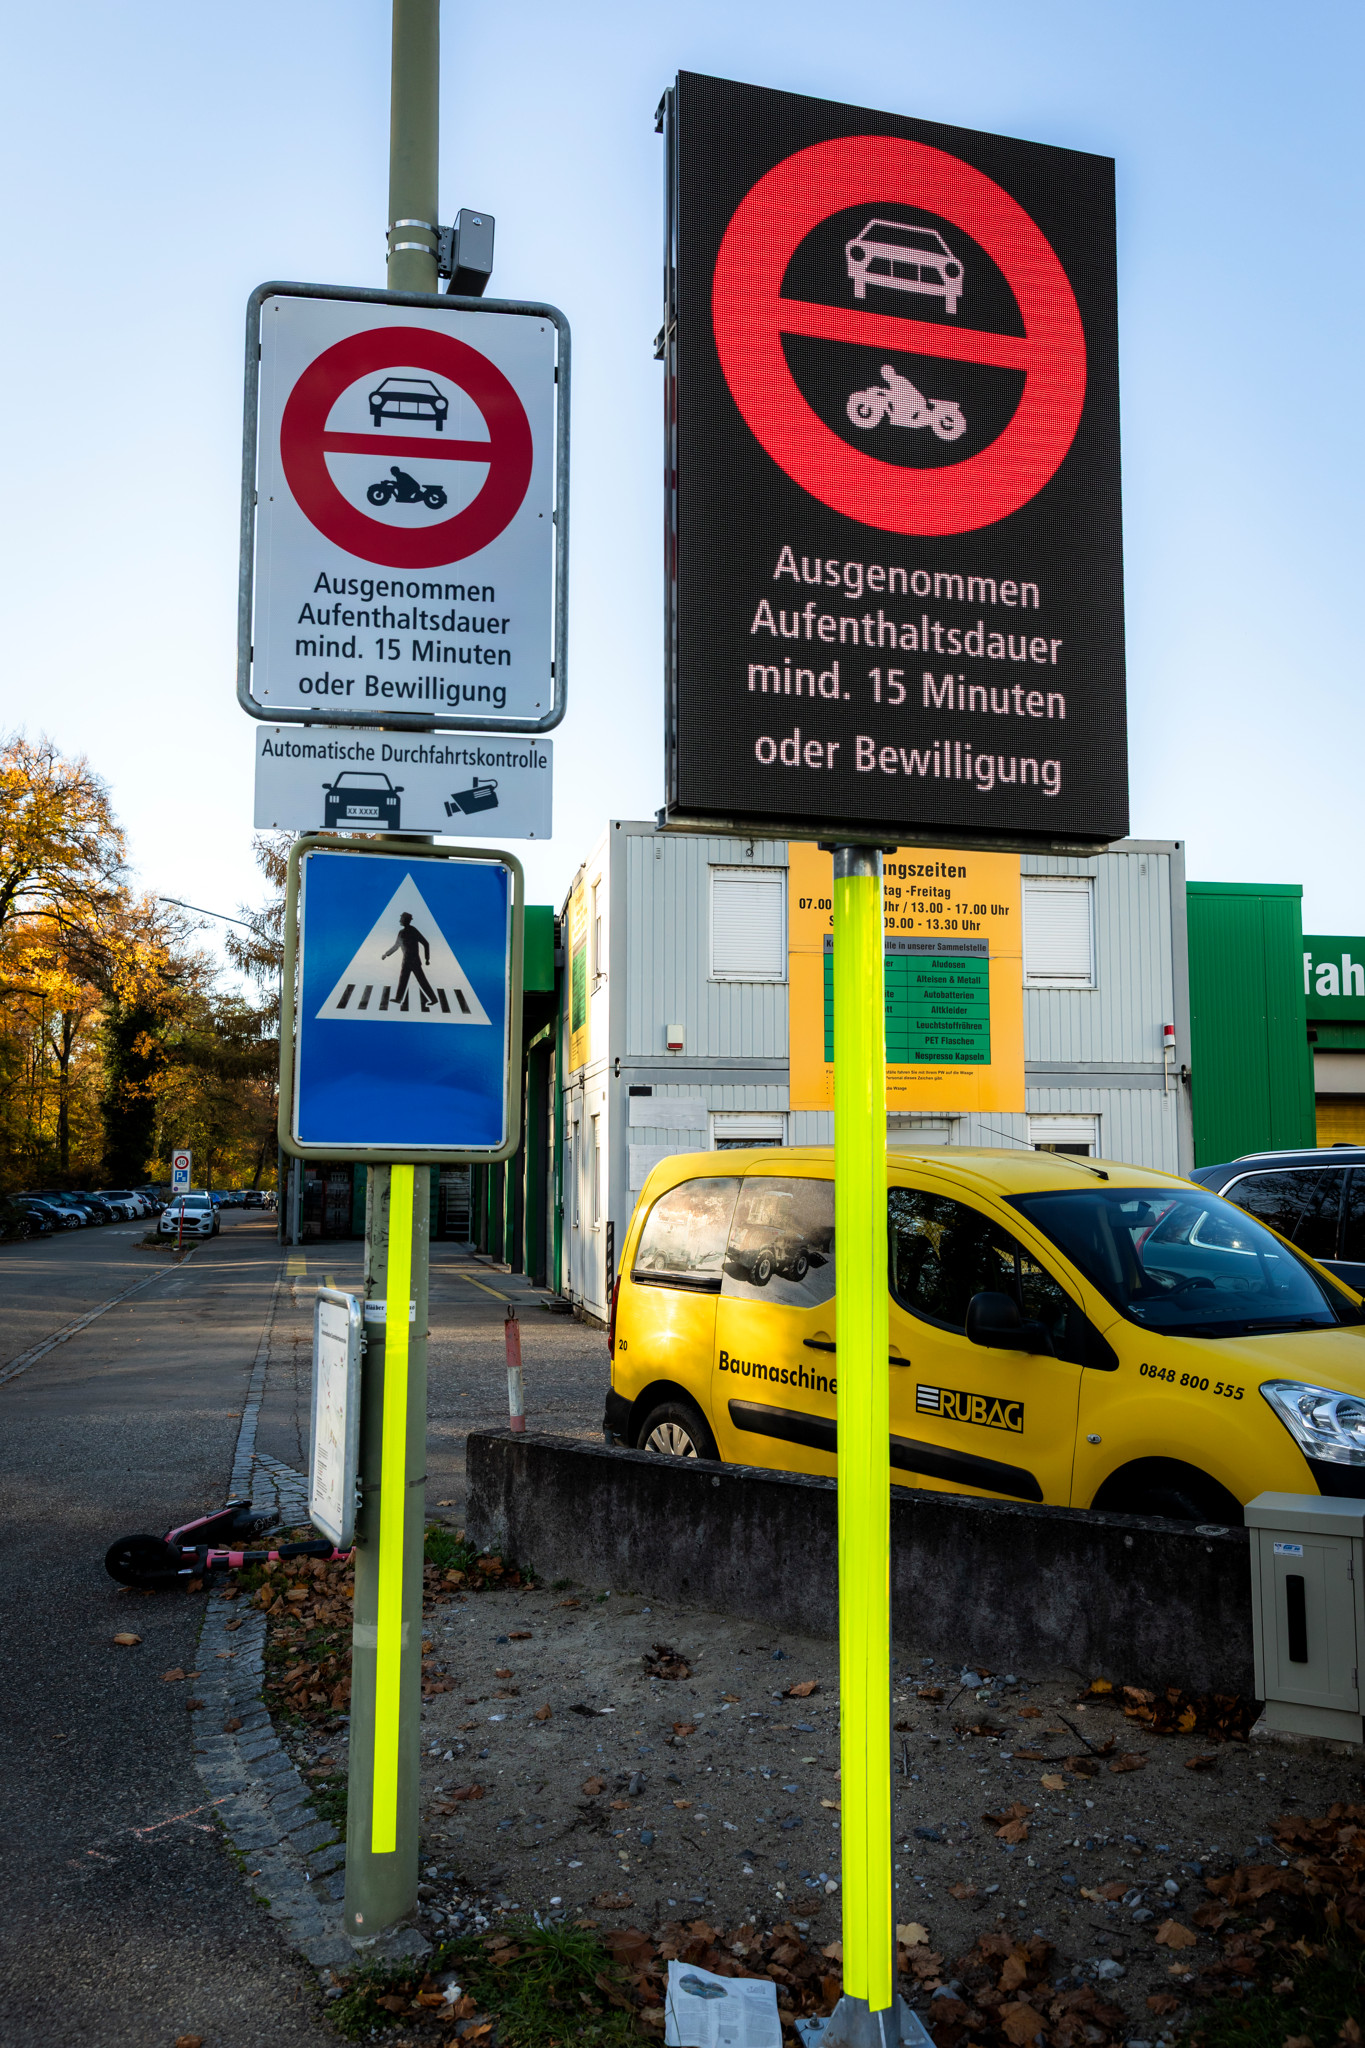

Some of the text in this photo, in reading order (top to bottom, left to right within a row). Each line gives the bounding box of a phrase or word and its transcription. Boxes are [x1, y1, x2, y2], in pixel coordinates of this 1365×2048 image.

[773, 545, 1040, 609] Ausgenommen
[313, 571, 495, 603] Ausgenommen
[297, 602, 511, 635] Aufenthaltsdauer
[751, 599, 1063, 665] Aufenthaltsdauer
[295, 635, 512, 667] mind. 15 Minuten
[298, 671, 507, 709] oder Bewilligung
[748, 657, 1066, 719] mind. 15 Minuten
[261, 738, 548, 769] Automatische Durchfahrtskontrolle
[755, 727, 1062, 796] oder Bewilligung
[347, 807, 379, 816] XX XXXX
[884, 884, 902, 899] tag
[799, 898, 832, 910] 07.00
[902, 902, 908, 914] /
[911, 902, 943, 914] 13.00
[955, 903, 987, 915] 17.00
[990, 904, 1010, 916] Uhr
[926, 918, 958, 930] 13.30
[961, 919, 981, 931] Uhr
[898, 941, 906, 950] in
[907, 943, 935, 951] unserer
[937, 943, 987, 952] Sammelstelle
[931, 960, 966, 969] Aludosen
[916, 975, 981, 984] Alteisen & Metall
[1303, 952, 1365, 997] fah
[923, 990, 975, 1000] Autobatterien
[930, 1005, 968, 1014] Altkleider
[916, 1021, 983, 1030] Leuchtstoffröhren
[924, 1036, 975, 1045] PET Flaschen
[915, 1051, 985, 1062] Nespresso Kapseln
[618, 1339, 628, 1351] 20
[1139, 1362, 1246, 1401] 0848 800 555
[939, 1389, 1023, 1433] RUBAG
